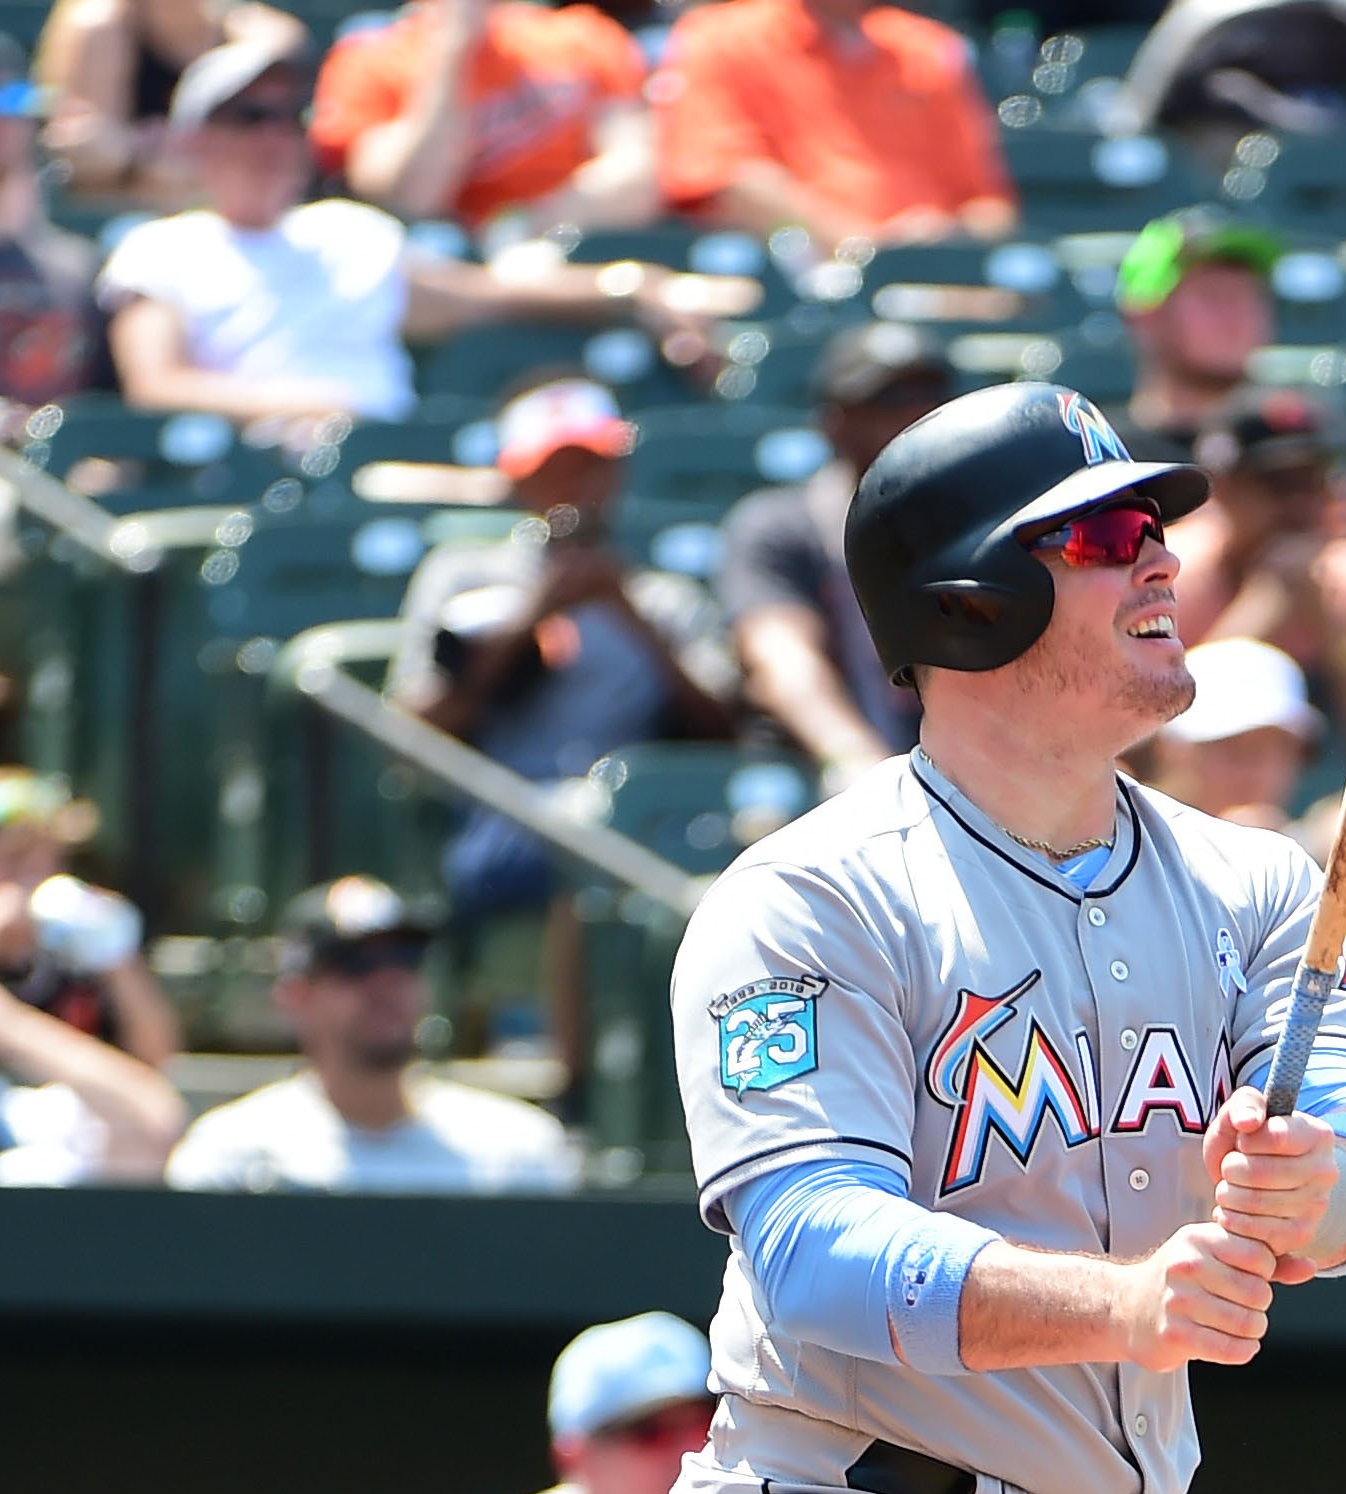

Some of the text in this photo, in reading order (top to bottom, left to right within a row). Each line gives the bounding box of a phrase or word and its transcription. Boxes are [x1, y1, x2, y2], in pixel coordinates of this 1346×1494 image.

[768, 980, 805, 994] 2018
[725, 1000, 808, 1078] 25
[934, 1012, 1236, 1204] MIA
